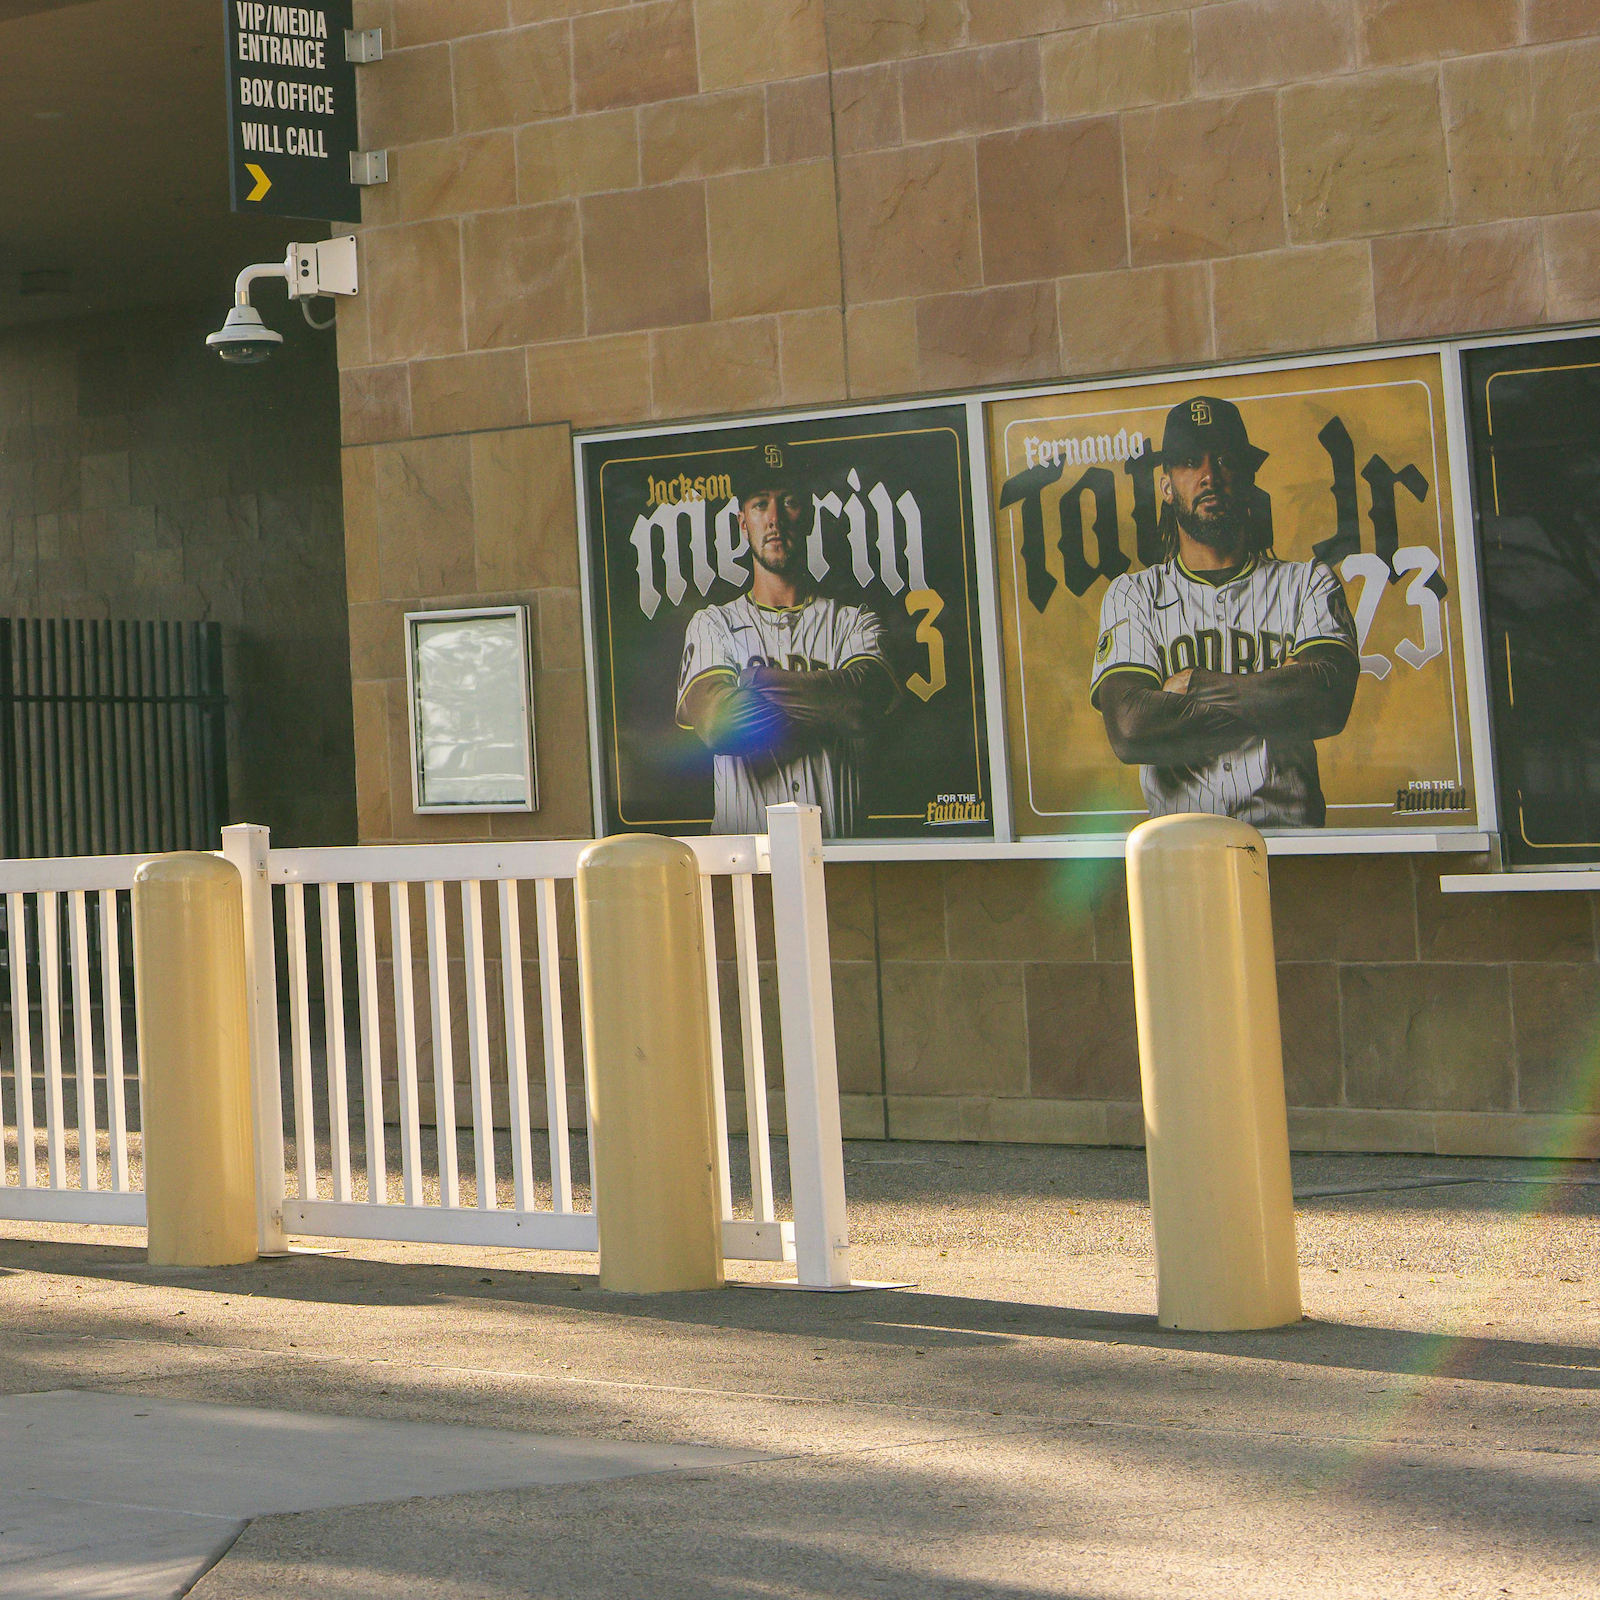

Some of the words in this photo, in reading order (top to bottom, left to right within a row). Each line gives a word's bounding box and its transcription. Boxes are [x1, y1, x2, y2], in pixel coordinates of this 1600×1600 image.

[236, 0, 328, 39] VIP/MEDIA
[238, 32, 326, 70] ENTRANCE
[240, 77, 275, 109] BOX
[277, 81, 335, 115] OFFICE
[241, 122, 284, 154] WILL
[286, 126, 328, 159] CALL
[1023, 427, 1145, 470] Fernando
[646, 472, 734, 507] Jackson
[1340, 545, 1444, 681] 23
[905, 588, 947, 702] 3
[937, 794, 956, 803] FOR
[957, 793, 976, 802] THE
[1408, 781, 1431, 790] FOR
[1432, 780, 1455, 789] THE
[927, 800, 986, 822] Faithful
